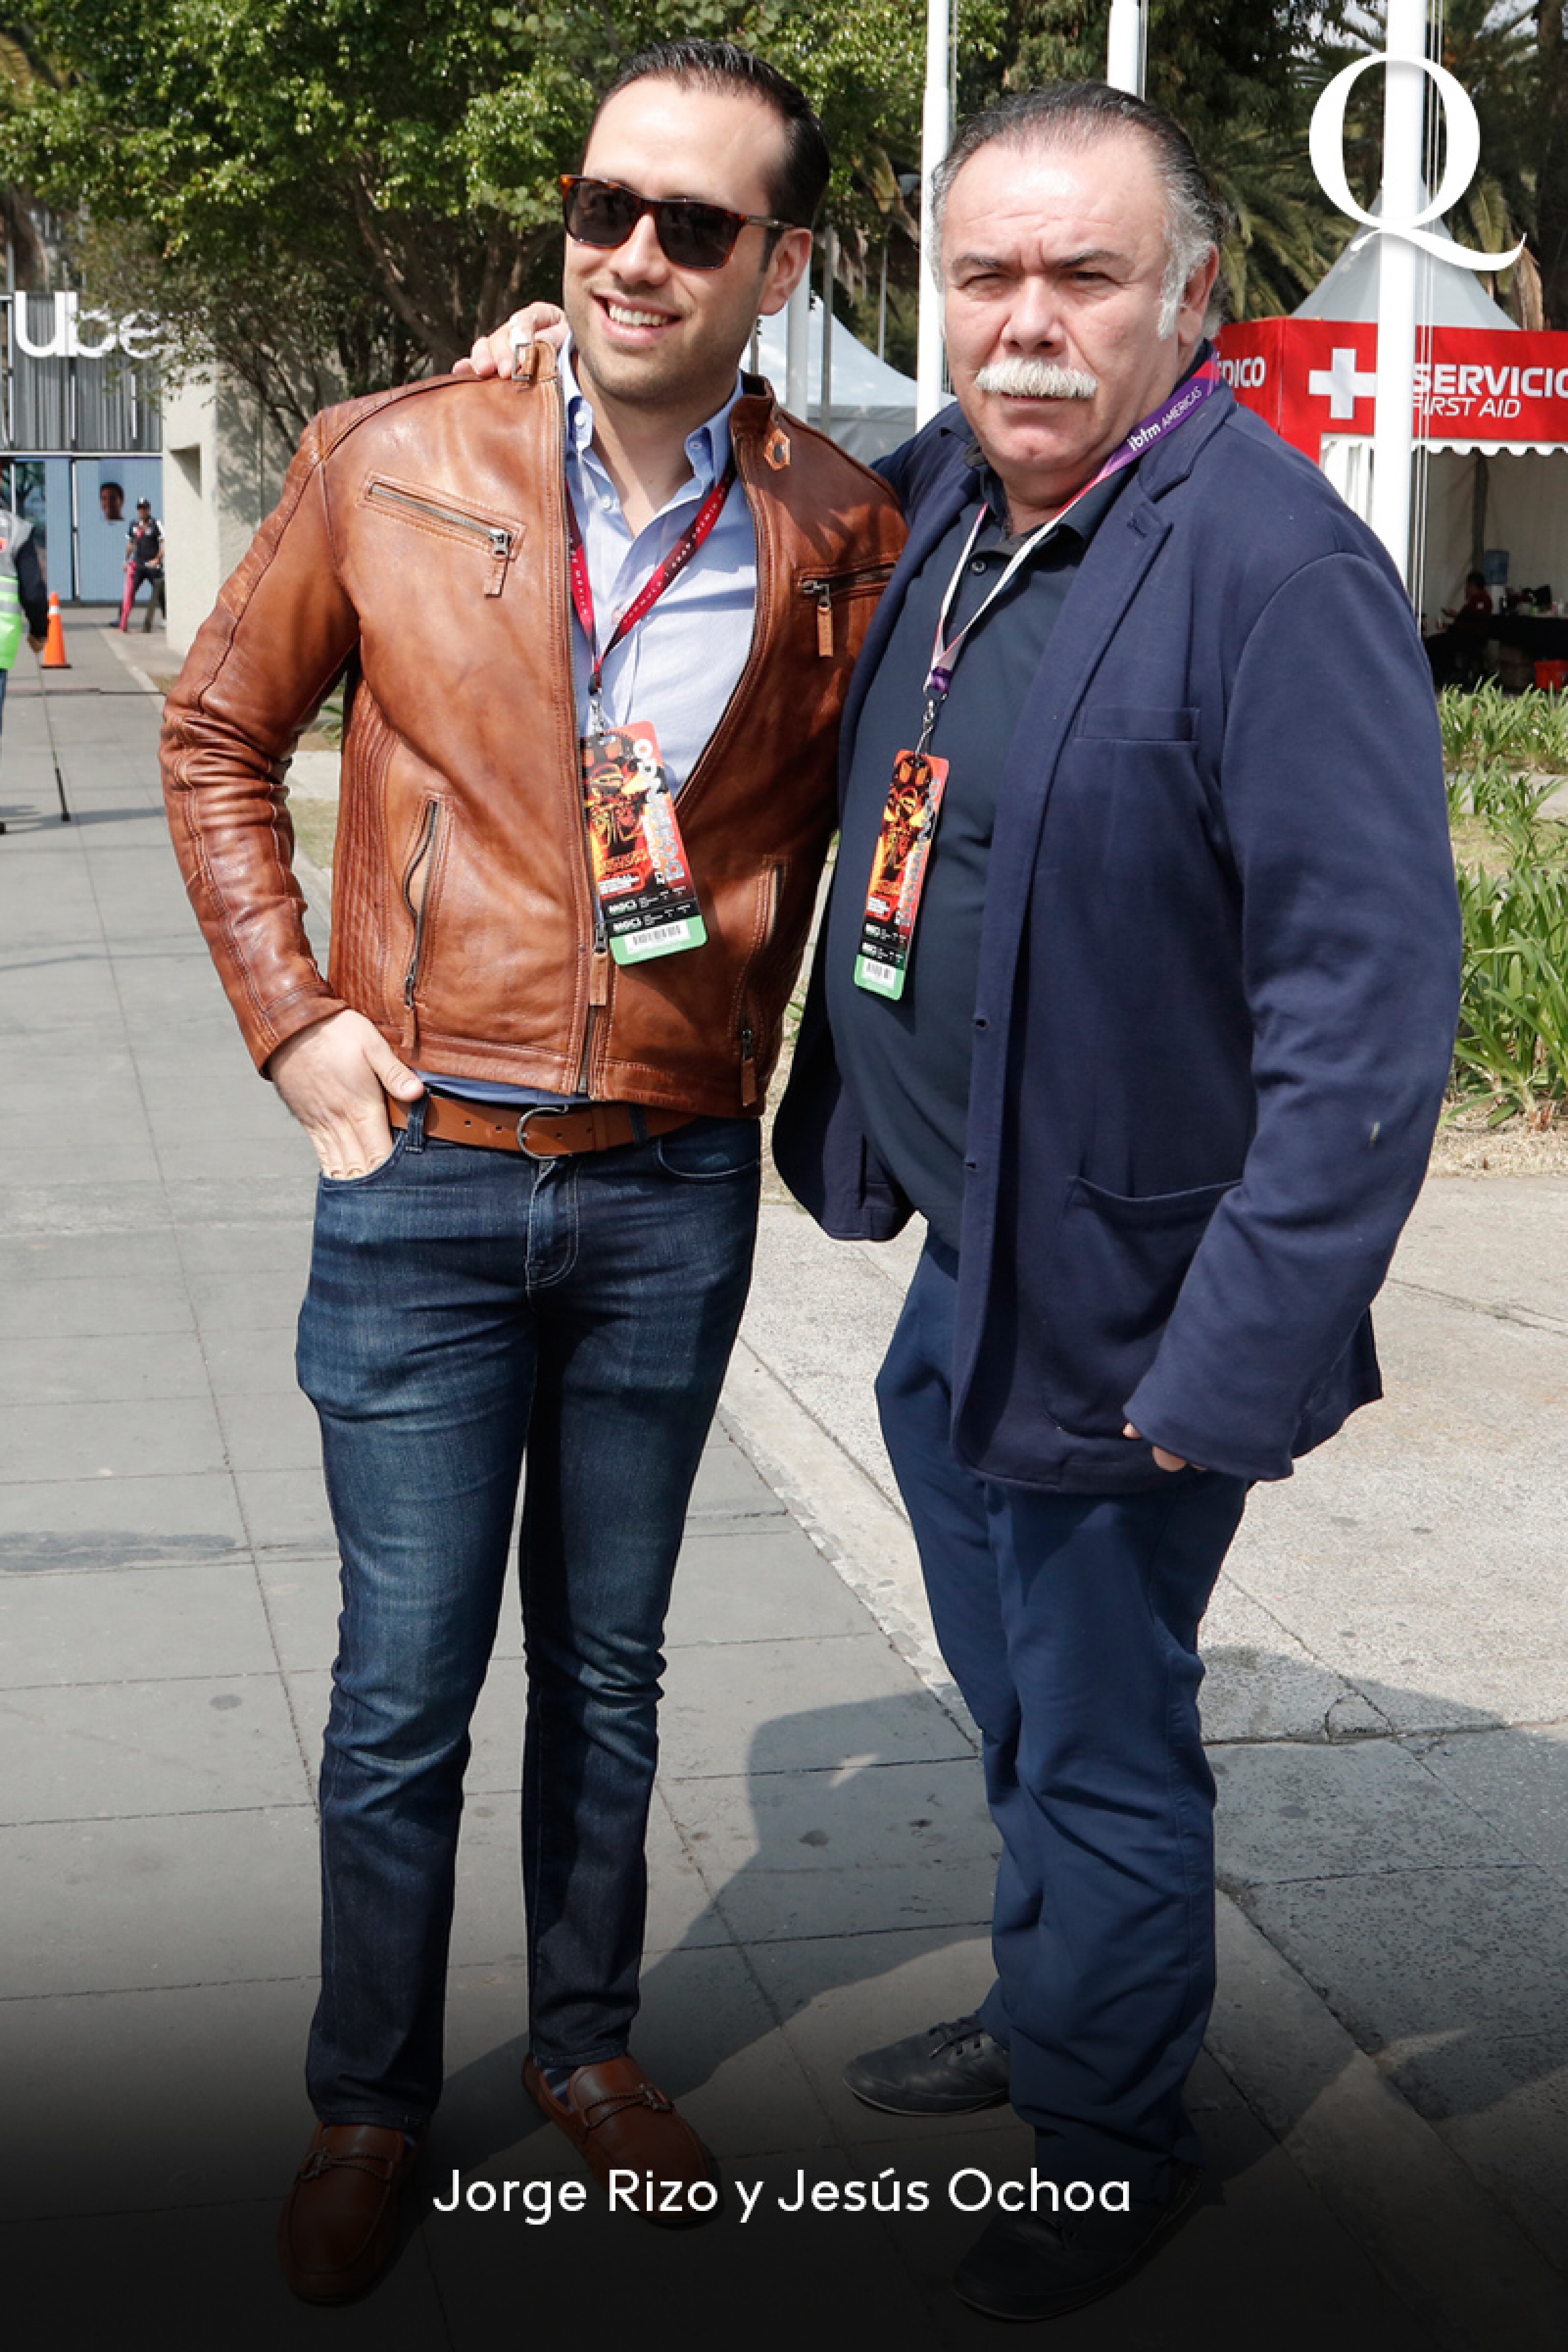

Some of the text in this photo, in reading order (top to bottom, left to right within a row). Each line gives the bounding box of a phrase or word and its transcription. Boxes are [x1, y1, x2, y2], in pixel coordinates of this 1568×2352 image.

[15, 290, 191, 359] Ube
[1217, 351, 1267, 388] DICO
[1127, 385, 1202, 451] ibtm AMERICAS
[1413, 395, 1521, 418] FIRST AID
[624, 580, 663, 623] FORMULA
[671, 542, 691, 568] GRAN
[632, 737, 685, 882] DOMINGO
